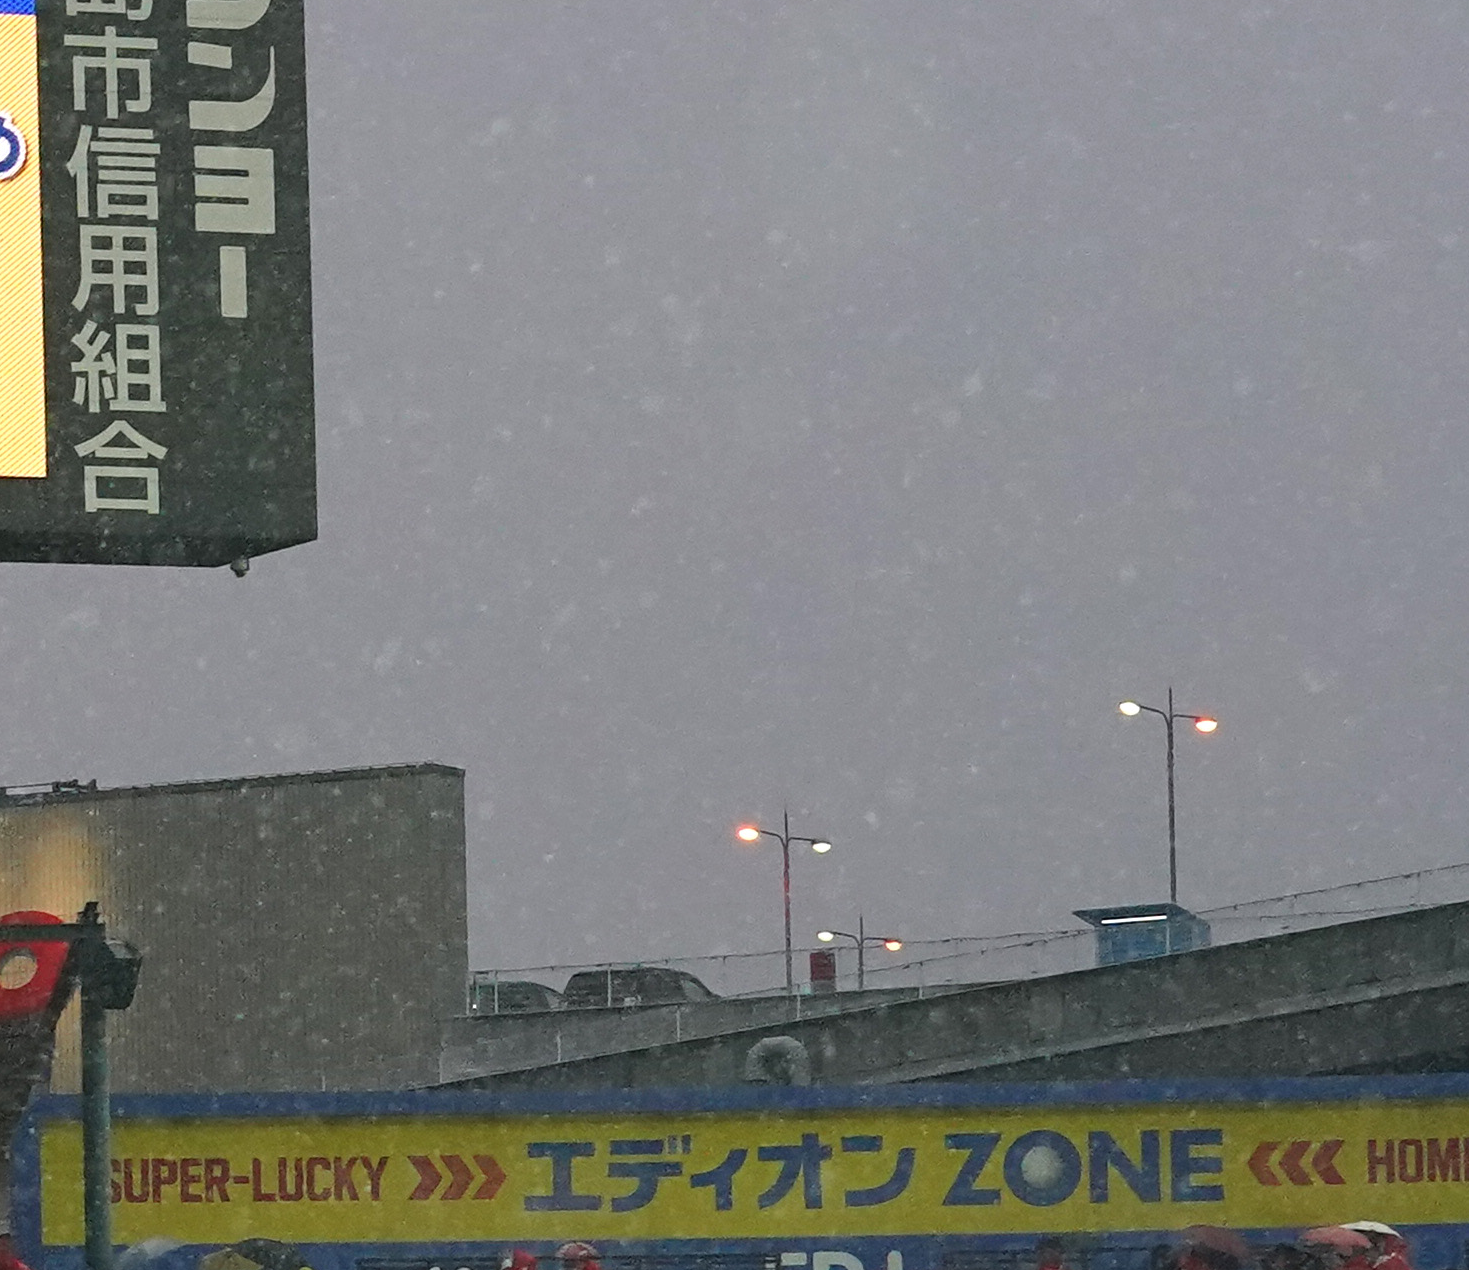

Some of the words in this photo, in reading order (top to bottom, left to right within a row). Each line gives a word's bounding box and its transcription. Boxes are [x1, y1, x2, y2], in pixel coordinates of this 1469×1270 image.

[524, 1134, 914, 1213] エディオン
[942, 1129, 1224, 1207] ZONE
[1368, 1138, 1469, 1185] HOM
